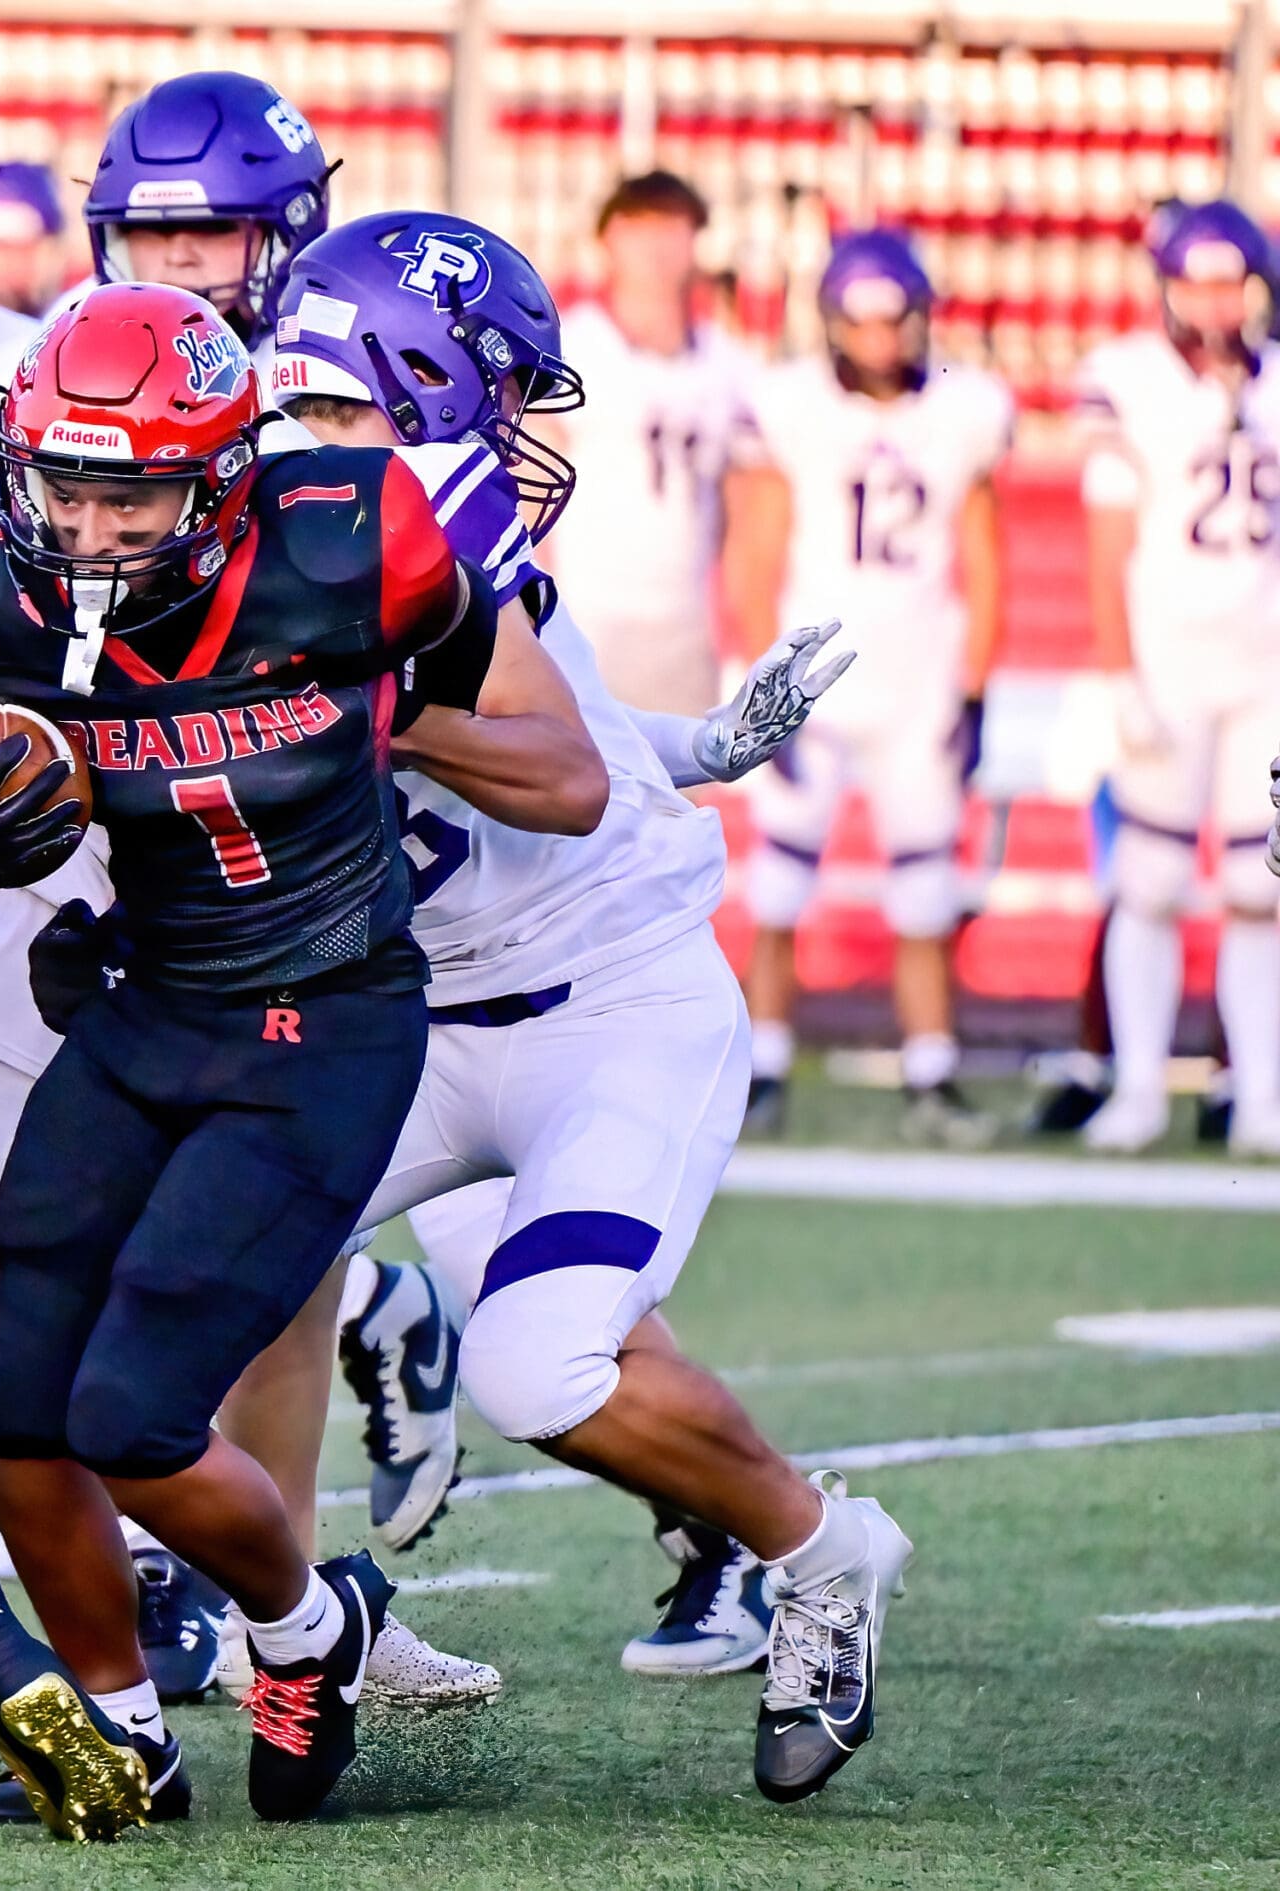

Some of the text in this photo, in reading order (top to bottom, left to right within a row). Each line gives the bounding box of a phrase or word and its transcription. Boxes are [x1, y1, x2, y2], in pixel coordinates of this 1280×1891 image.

[51, 426, 120, 448] Riddell
[278, 483, 356, 510] 1
[851, 474, 927, 568] 12
[170, 774, 271, 889] 1
[261, 1007, 302, 1044] R
